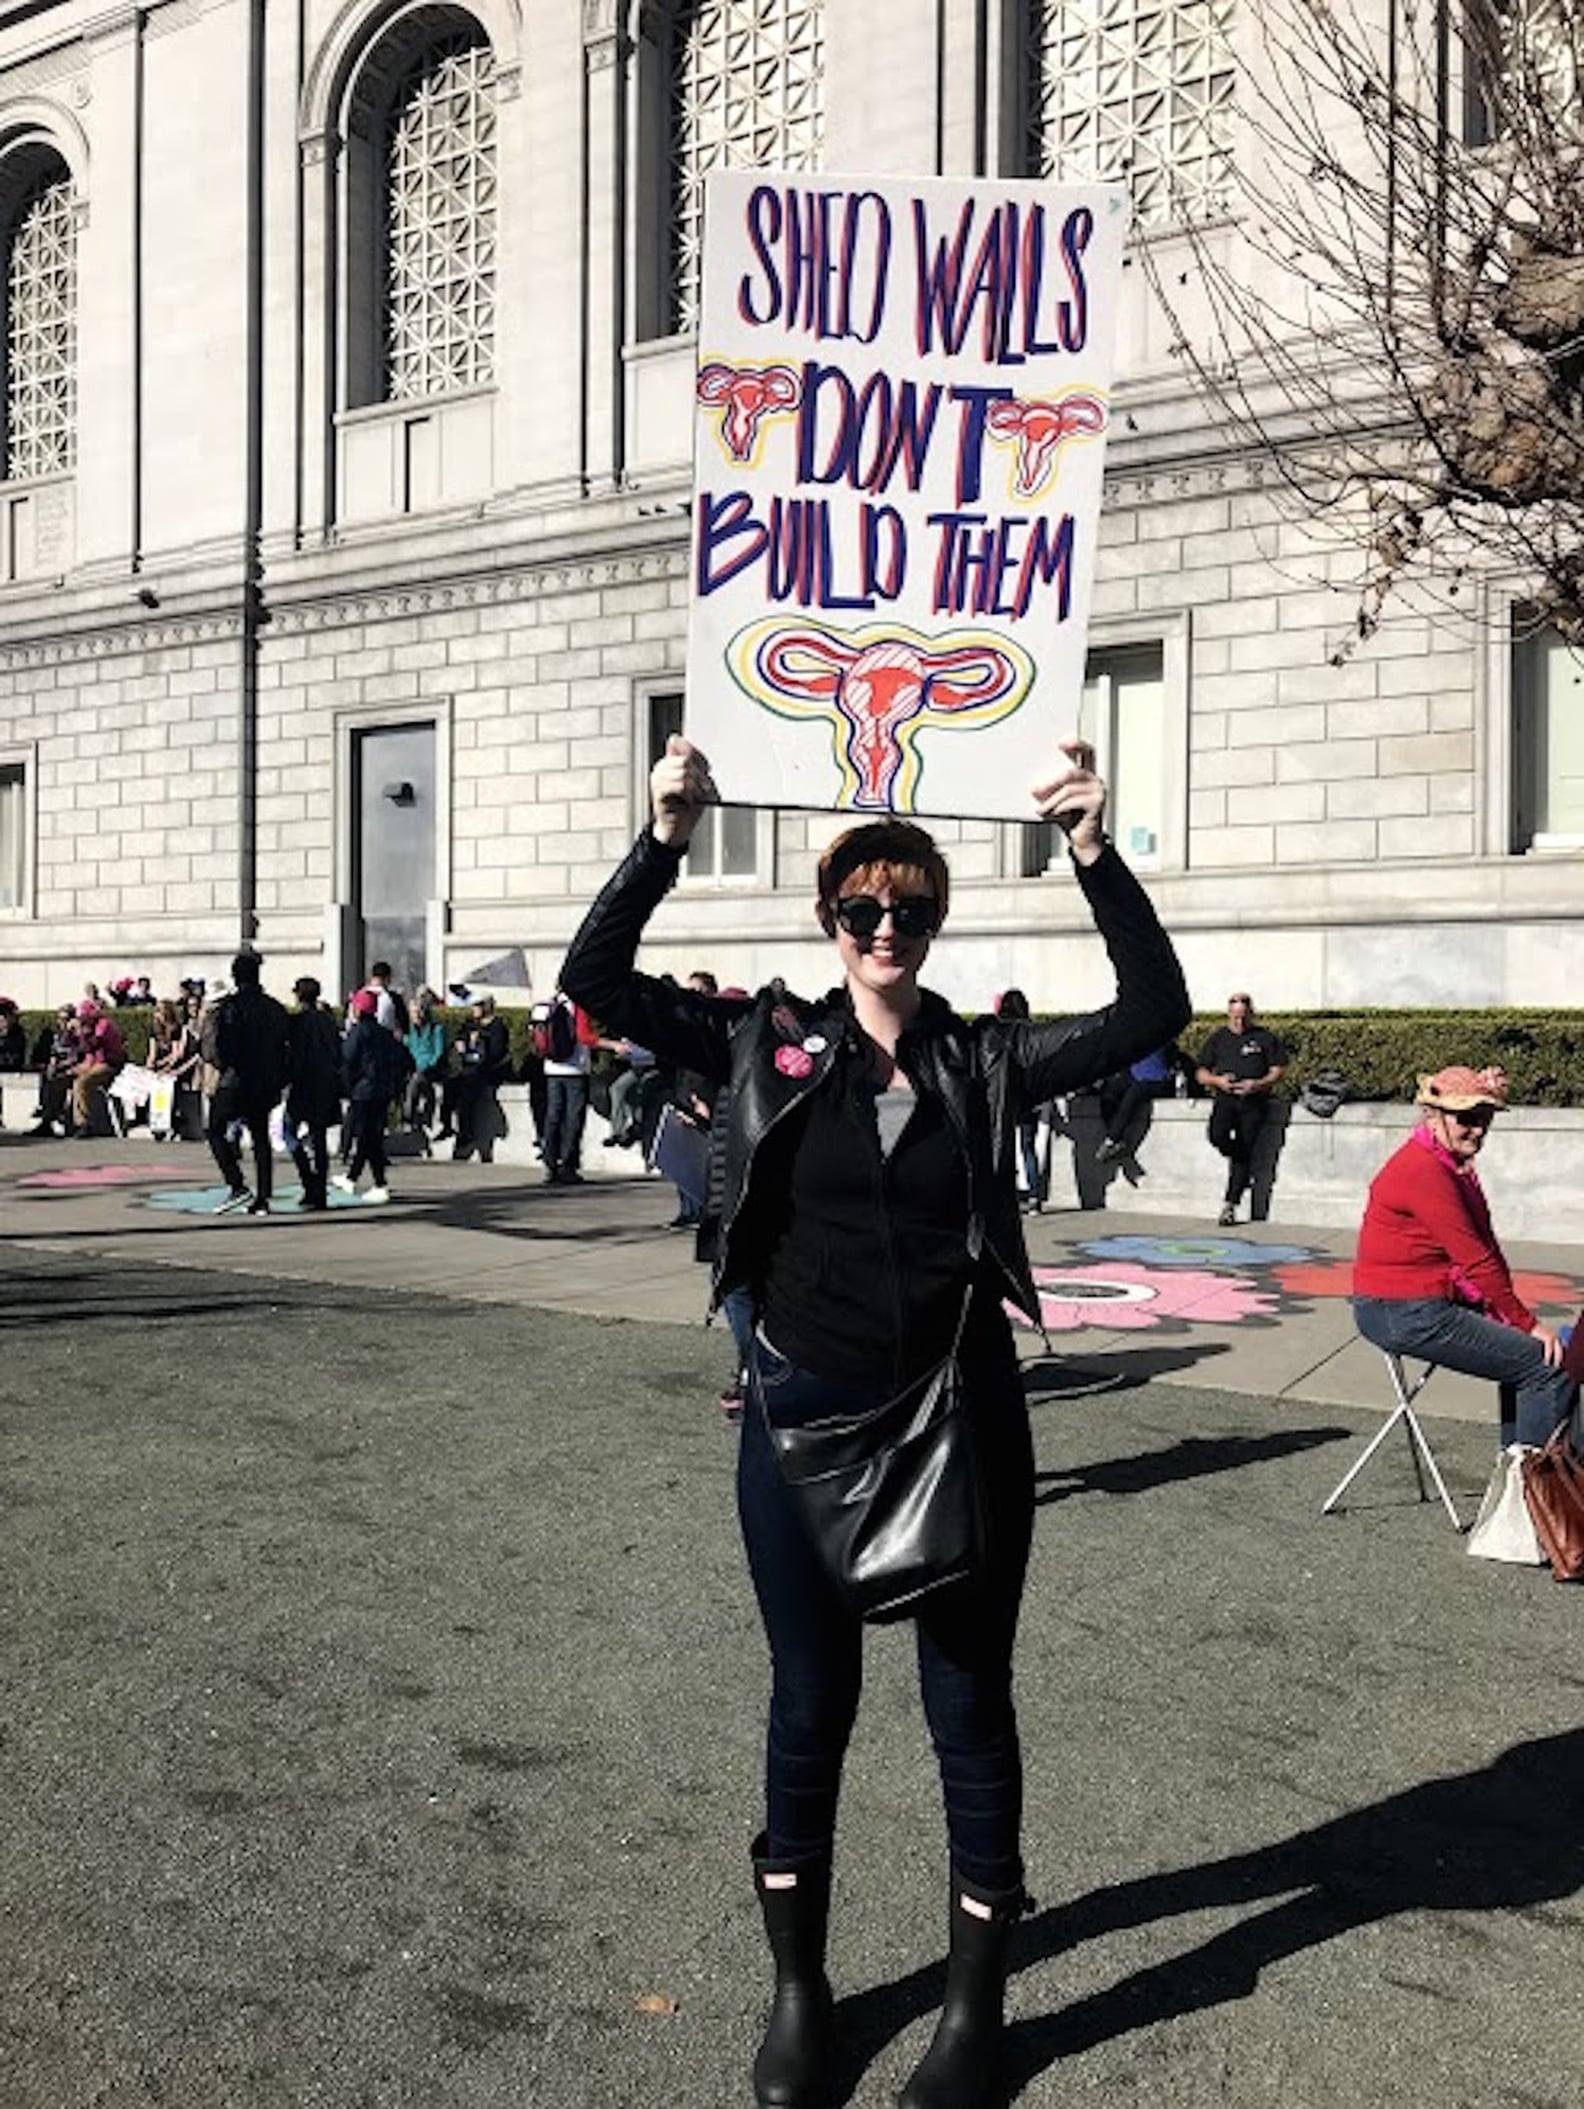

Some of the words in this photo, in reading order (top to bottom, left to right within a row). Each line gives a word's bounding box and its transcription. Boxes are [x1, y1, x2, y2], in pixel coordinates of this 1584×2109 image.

[738, 186, 891, 343] SHED
[912, 197, 1094, 365] WALLS
[795, 361, 1014, 509] DONT
[697, 491, 907, 609] BUILD
[926, 513, 1076, 624] THEM
